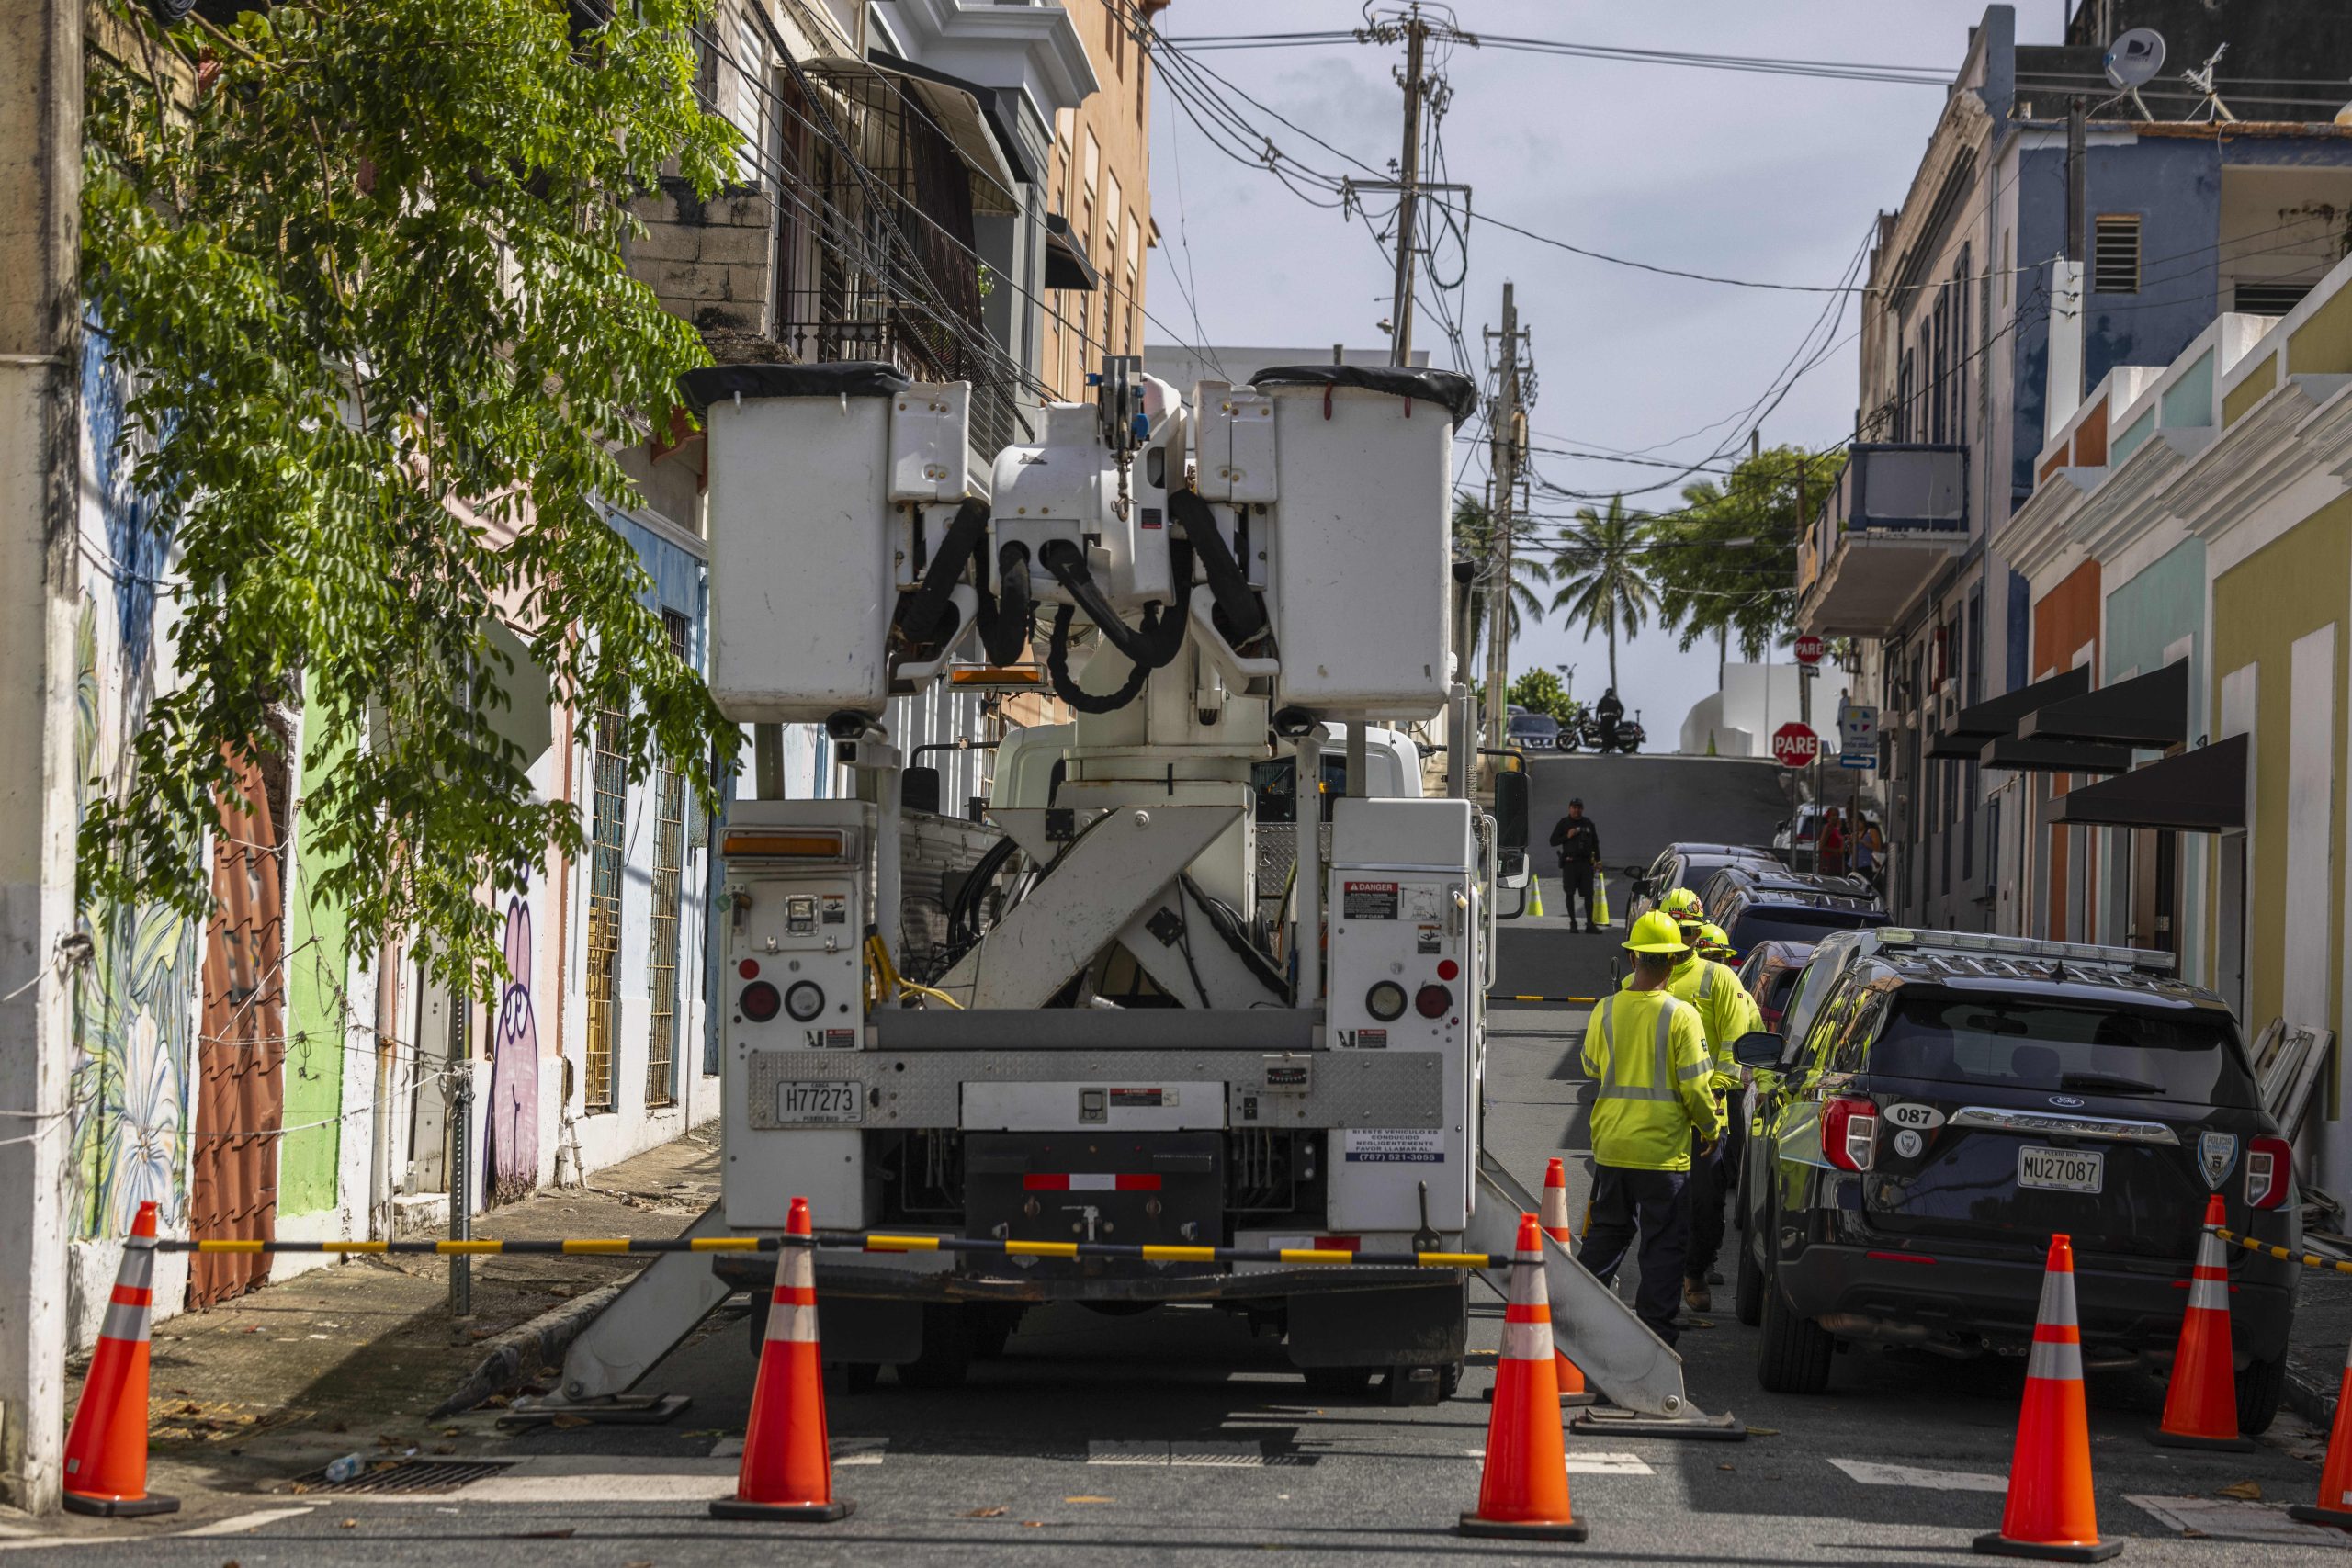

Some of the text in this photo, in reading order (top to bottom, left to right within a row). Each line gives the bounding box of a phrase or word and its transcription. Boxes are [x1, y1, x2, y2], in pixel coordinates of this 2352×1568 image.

[1795, 643, 1823, 655] PARE
[1775, 736, 1815, 754] PARE
[1359, 883, 1393, 891] DANGER
[786, 1089, 853, 1111] H77273
[2057, 1097, 2076, 1105] Ford
[1896, 1107, 1931, 1124] 087
[1360, 1153, 1385, 1162] (787)
[2023, 1156, 2097, 1183] MU27087
